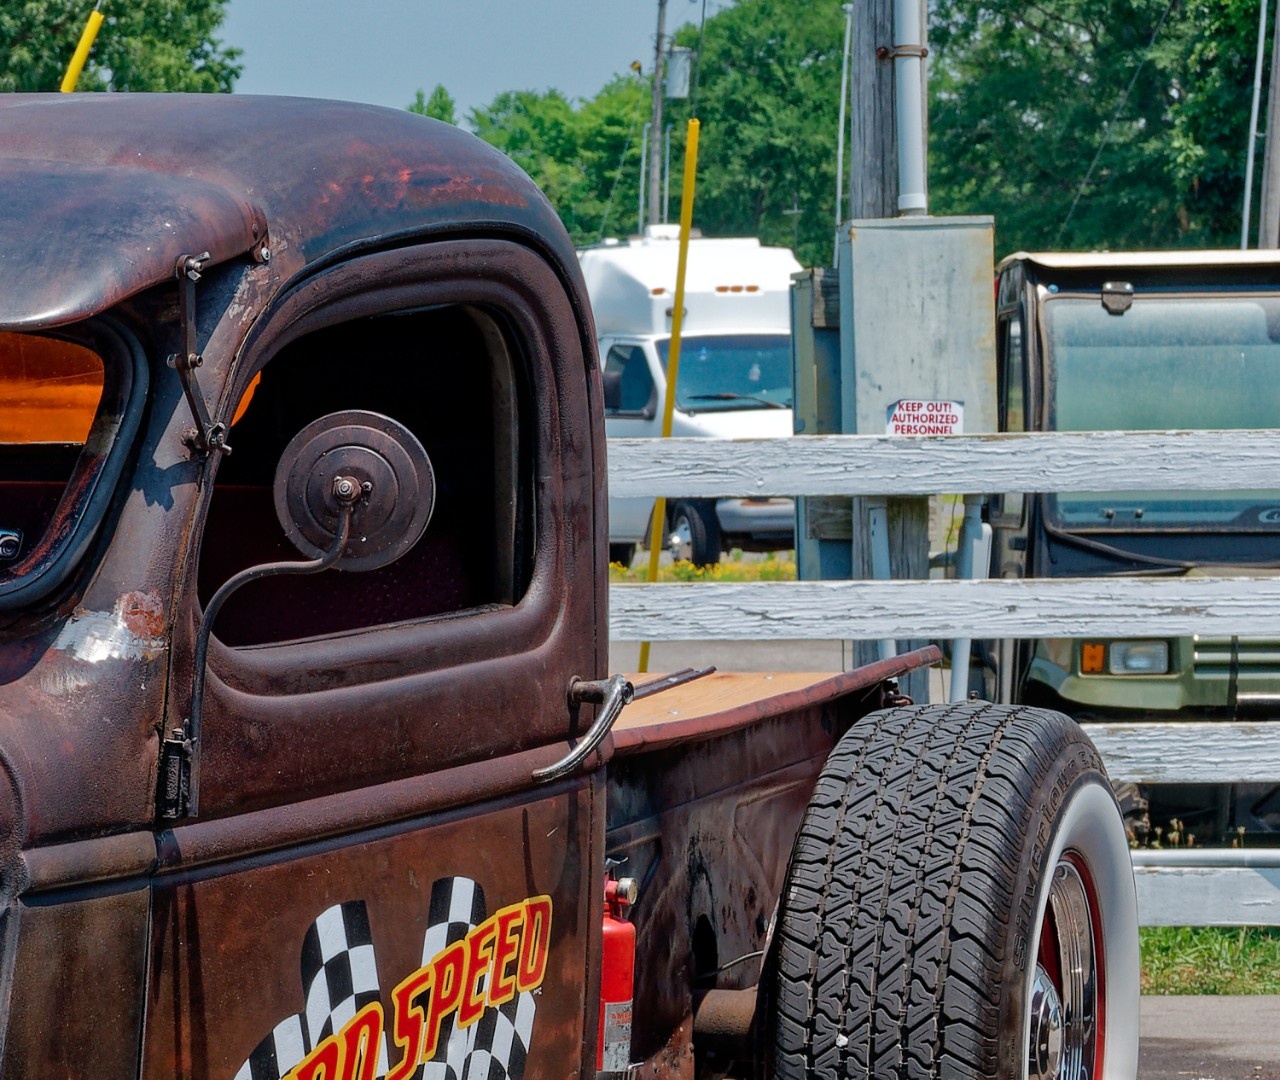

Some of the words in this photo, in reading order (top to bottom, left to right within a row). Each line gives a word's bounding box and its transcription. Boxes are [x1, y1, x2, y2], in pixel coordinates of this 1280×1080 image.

[898, 402, 923, 413] KEEP
[926, 402, 952, 413] OUT!
[891, 413, 959, 424] AUTHORIZED
[894, 424, 954, 435] PERSONNEL
